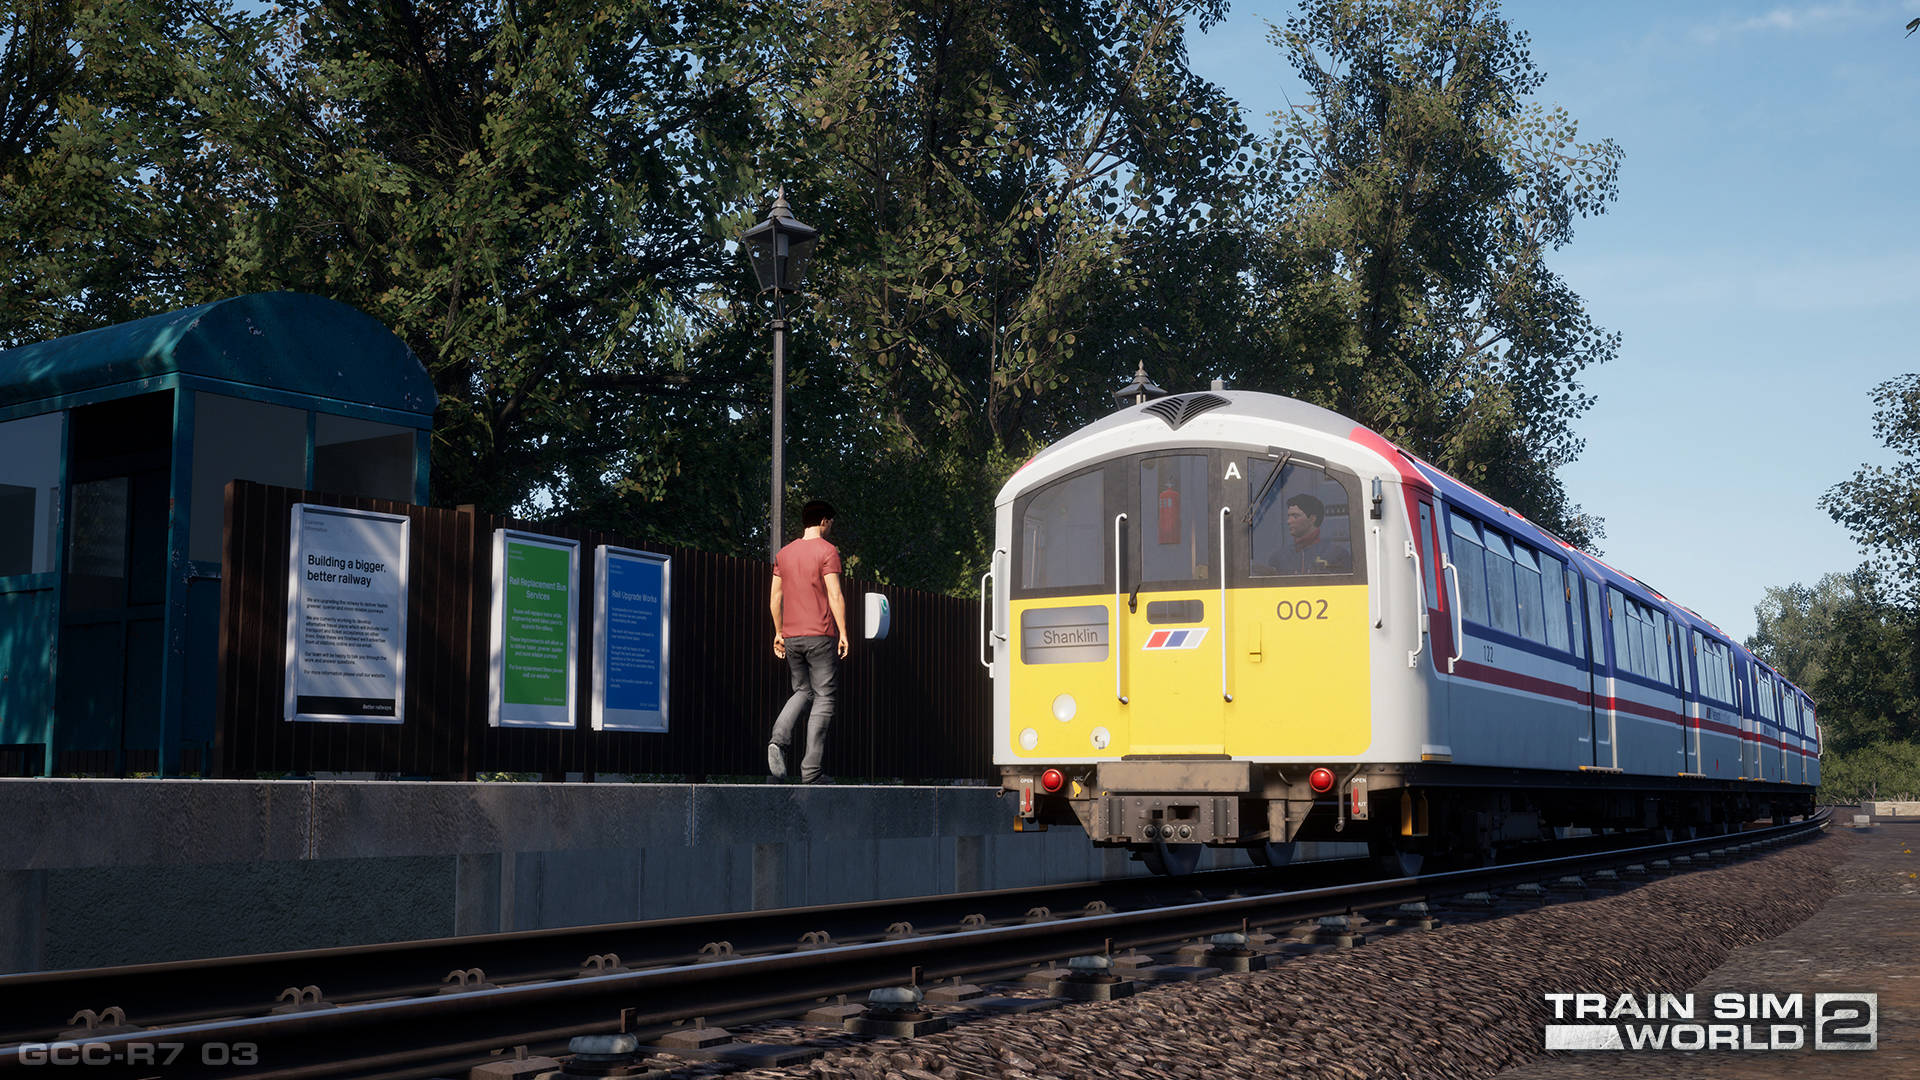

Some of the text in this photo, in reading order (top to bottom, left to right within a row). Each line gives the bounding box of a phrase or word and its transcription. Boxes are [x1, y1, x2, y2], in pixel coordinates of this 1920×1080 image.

[1224, 461, 1241, 480] A
[307, 554, 387, 574] Building a bigger,
[307, 570, 371, 588] better railway
[1277, 599, 1328, 621] 002
[1043, 628, 1098, 645] Shanklin
